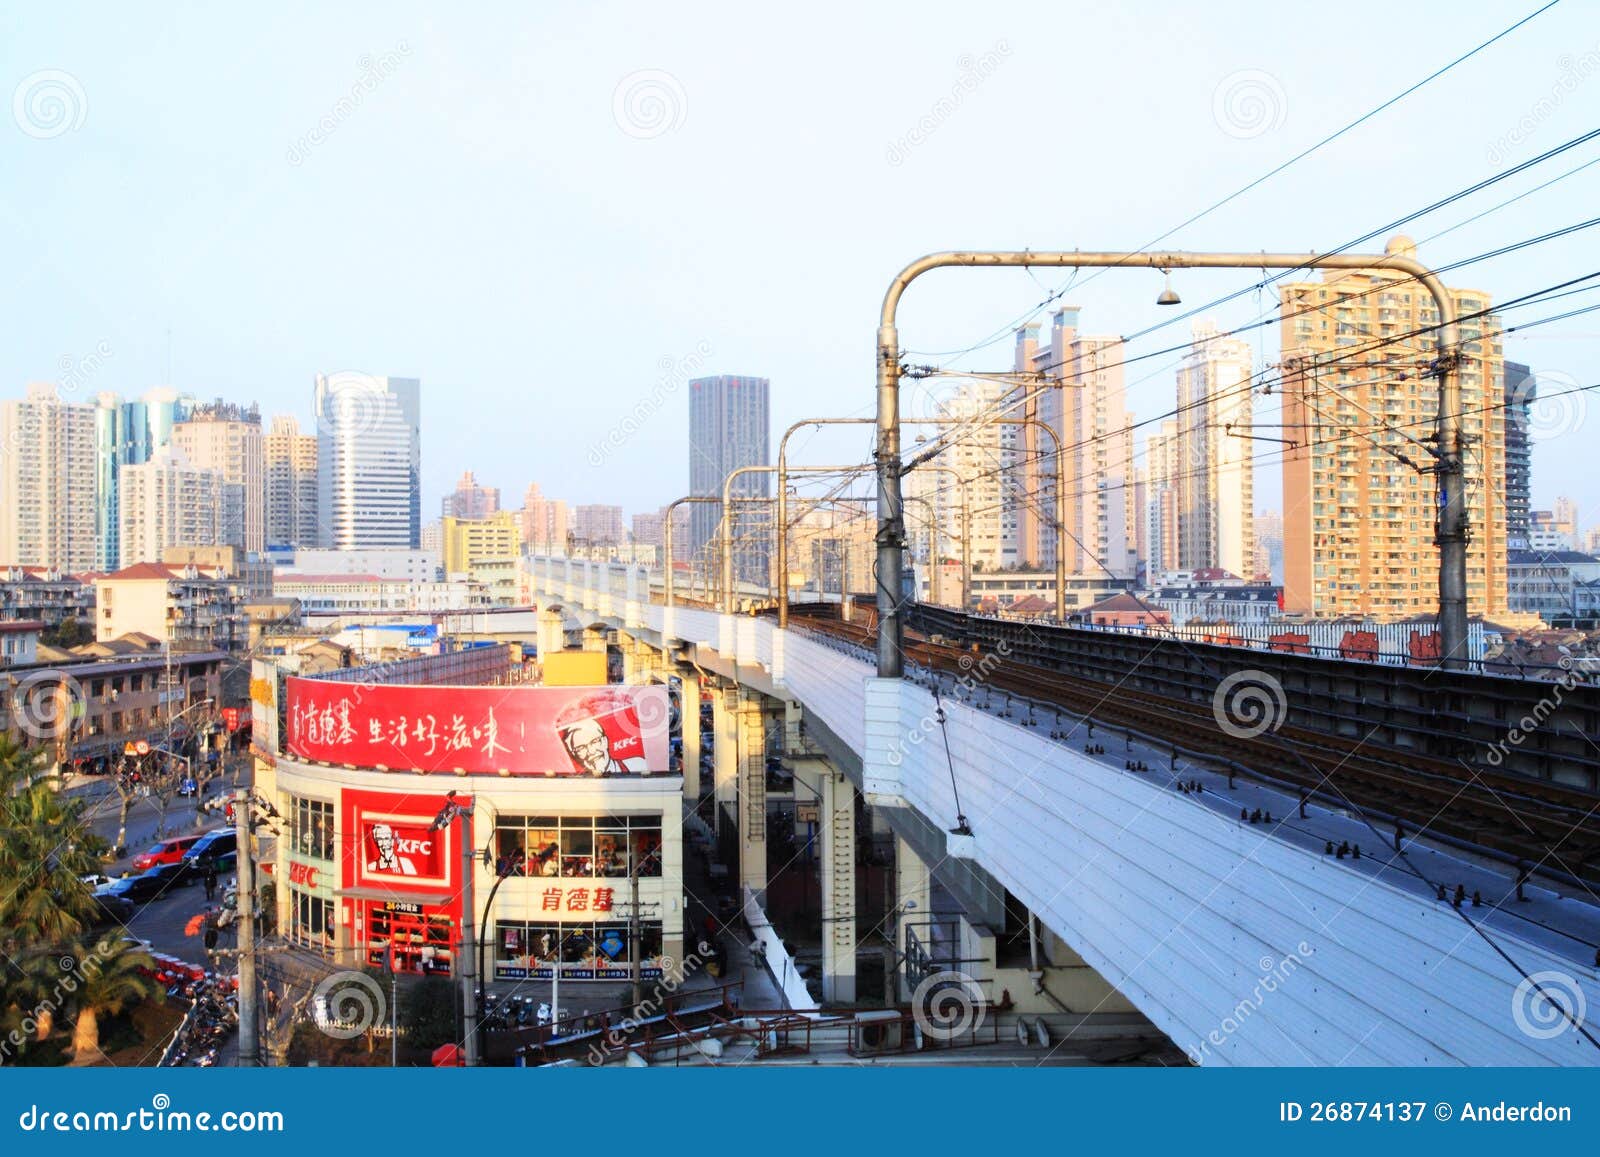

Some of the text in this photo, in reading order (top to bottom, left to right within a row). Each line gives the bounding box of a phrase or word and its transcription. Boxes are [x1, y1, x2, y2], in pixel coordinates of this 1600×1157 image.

[613, 736, 637, 751] KFC
[397, 840, 432, 855] KFC
[290, 860, 318, 888] KFC
[542, 887, 614, 911] 肯德基
